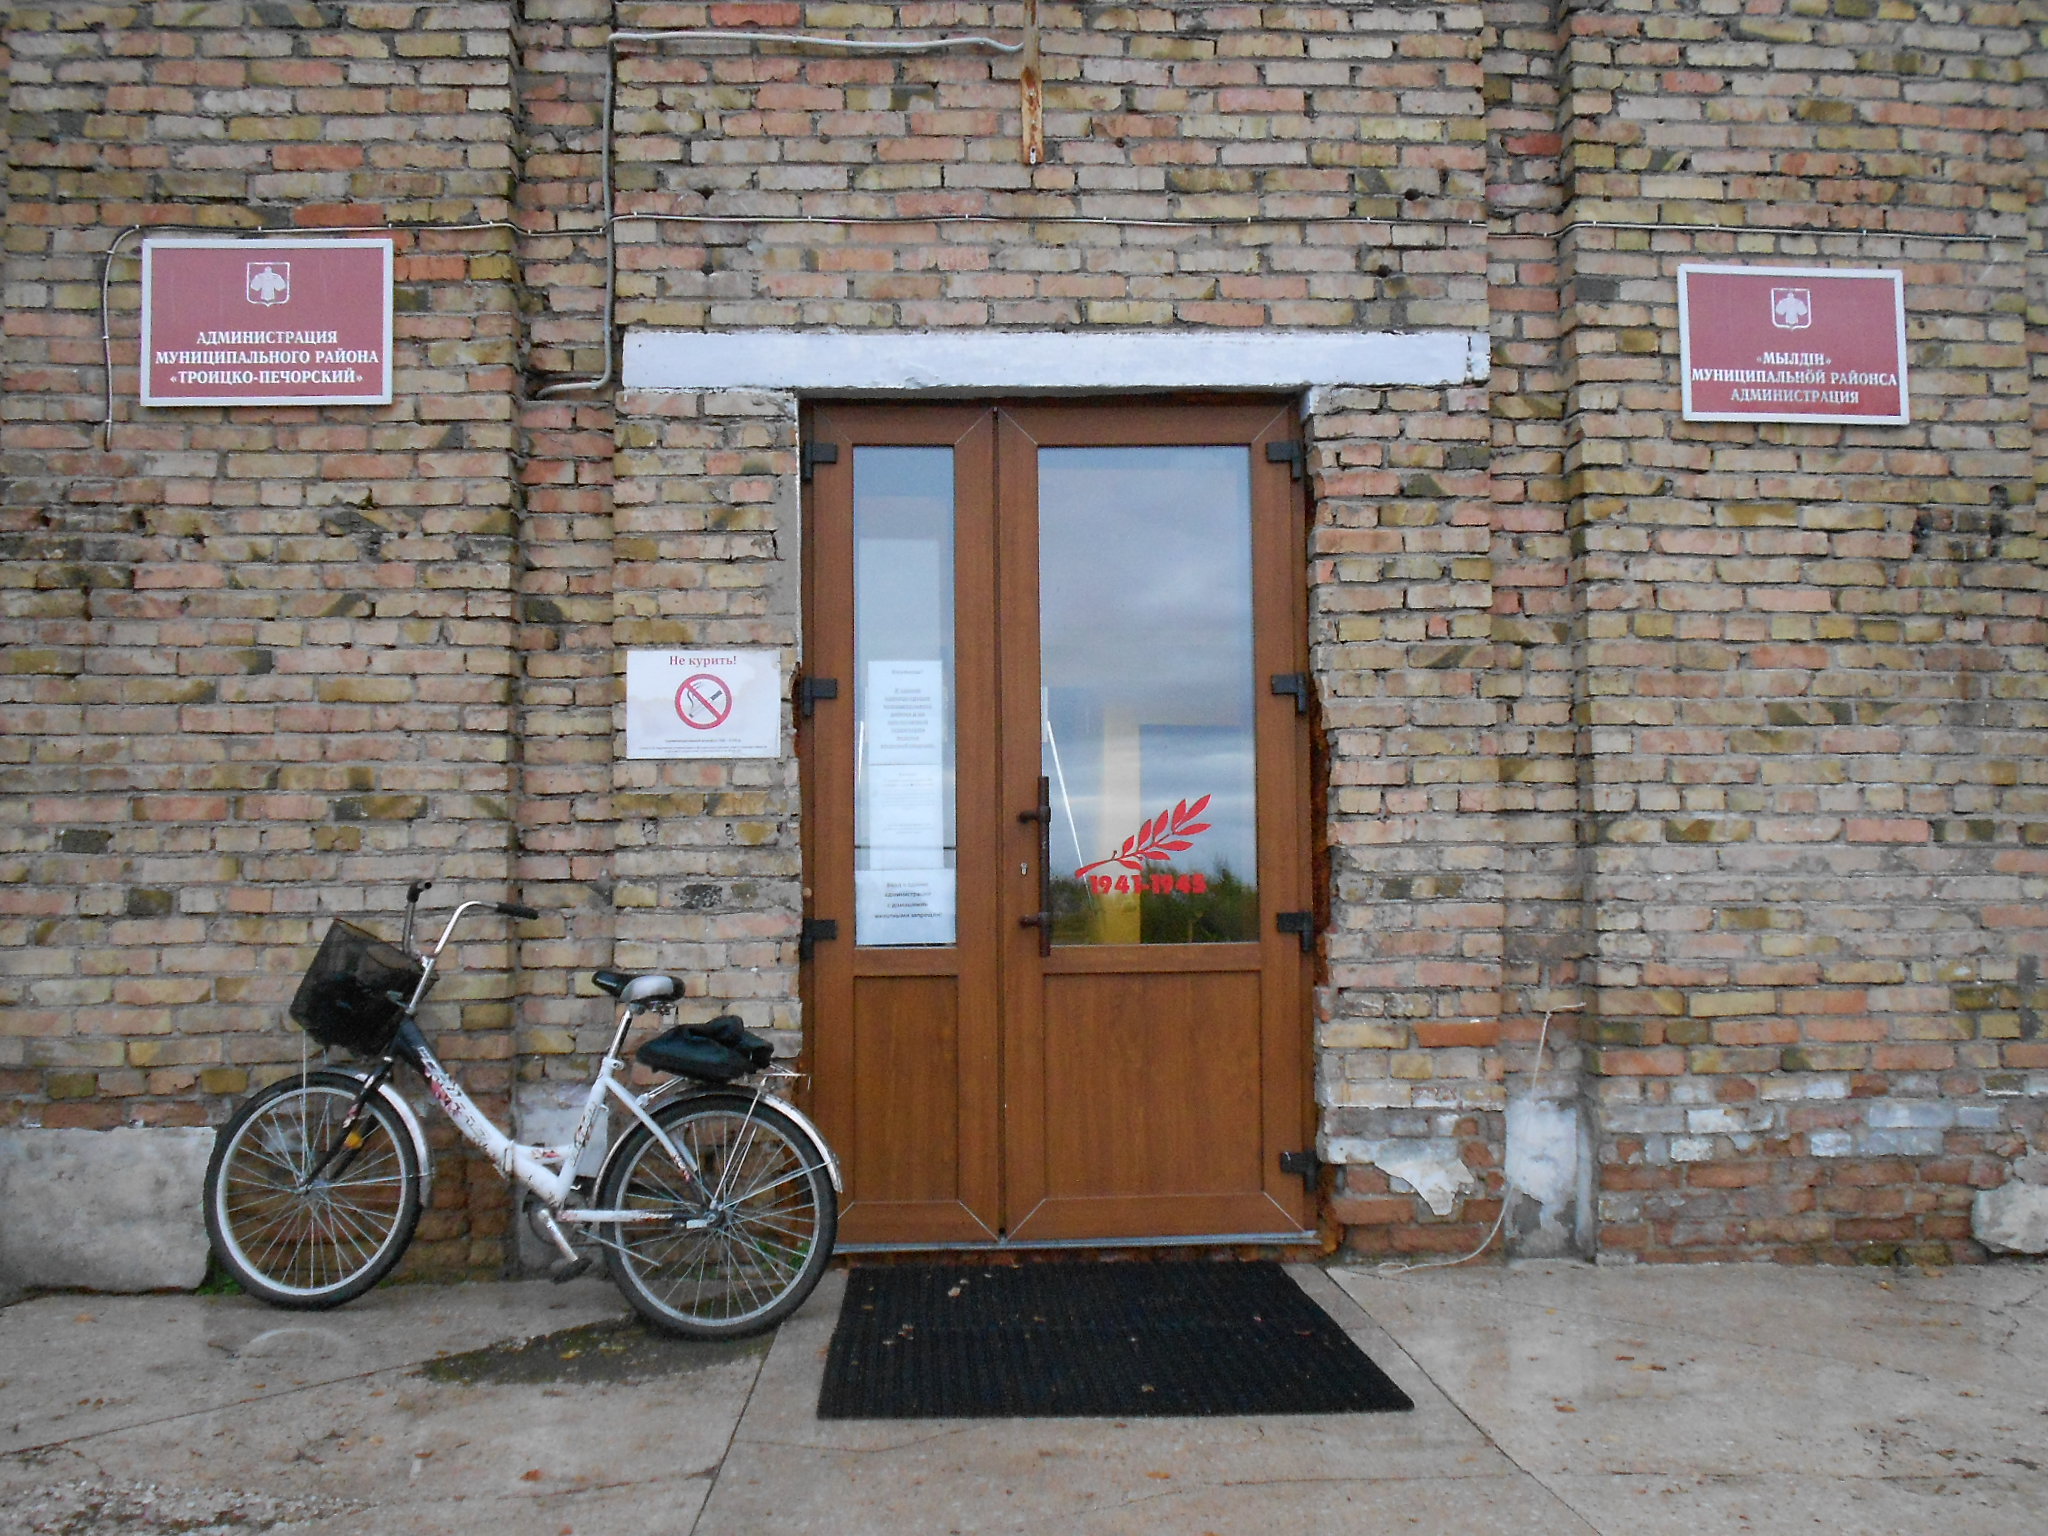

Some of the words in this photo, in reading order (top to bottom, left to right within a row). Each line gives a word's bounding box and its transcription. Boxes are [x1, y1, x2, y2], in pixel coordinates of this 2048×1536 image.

[196, 330, 338, 346] АДМИНИСТРАЦИЯ
[155, 350, 311, 366] МУНИЦИПАЛЬНОГО
[315, 348, 380, 364] РАЙОНА
[1830, 370, 1899, 386] РАЙОНСА
[1730, 388, 1860, 405] АДМИНИСТРАЦИЯ
[669, 655, 686, 666] Не
[689, 655, 737, 668] курить!
[1090, 873, 1207, 894] 1941-1945
